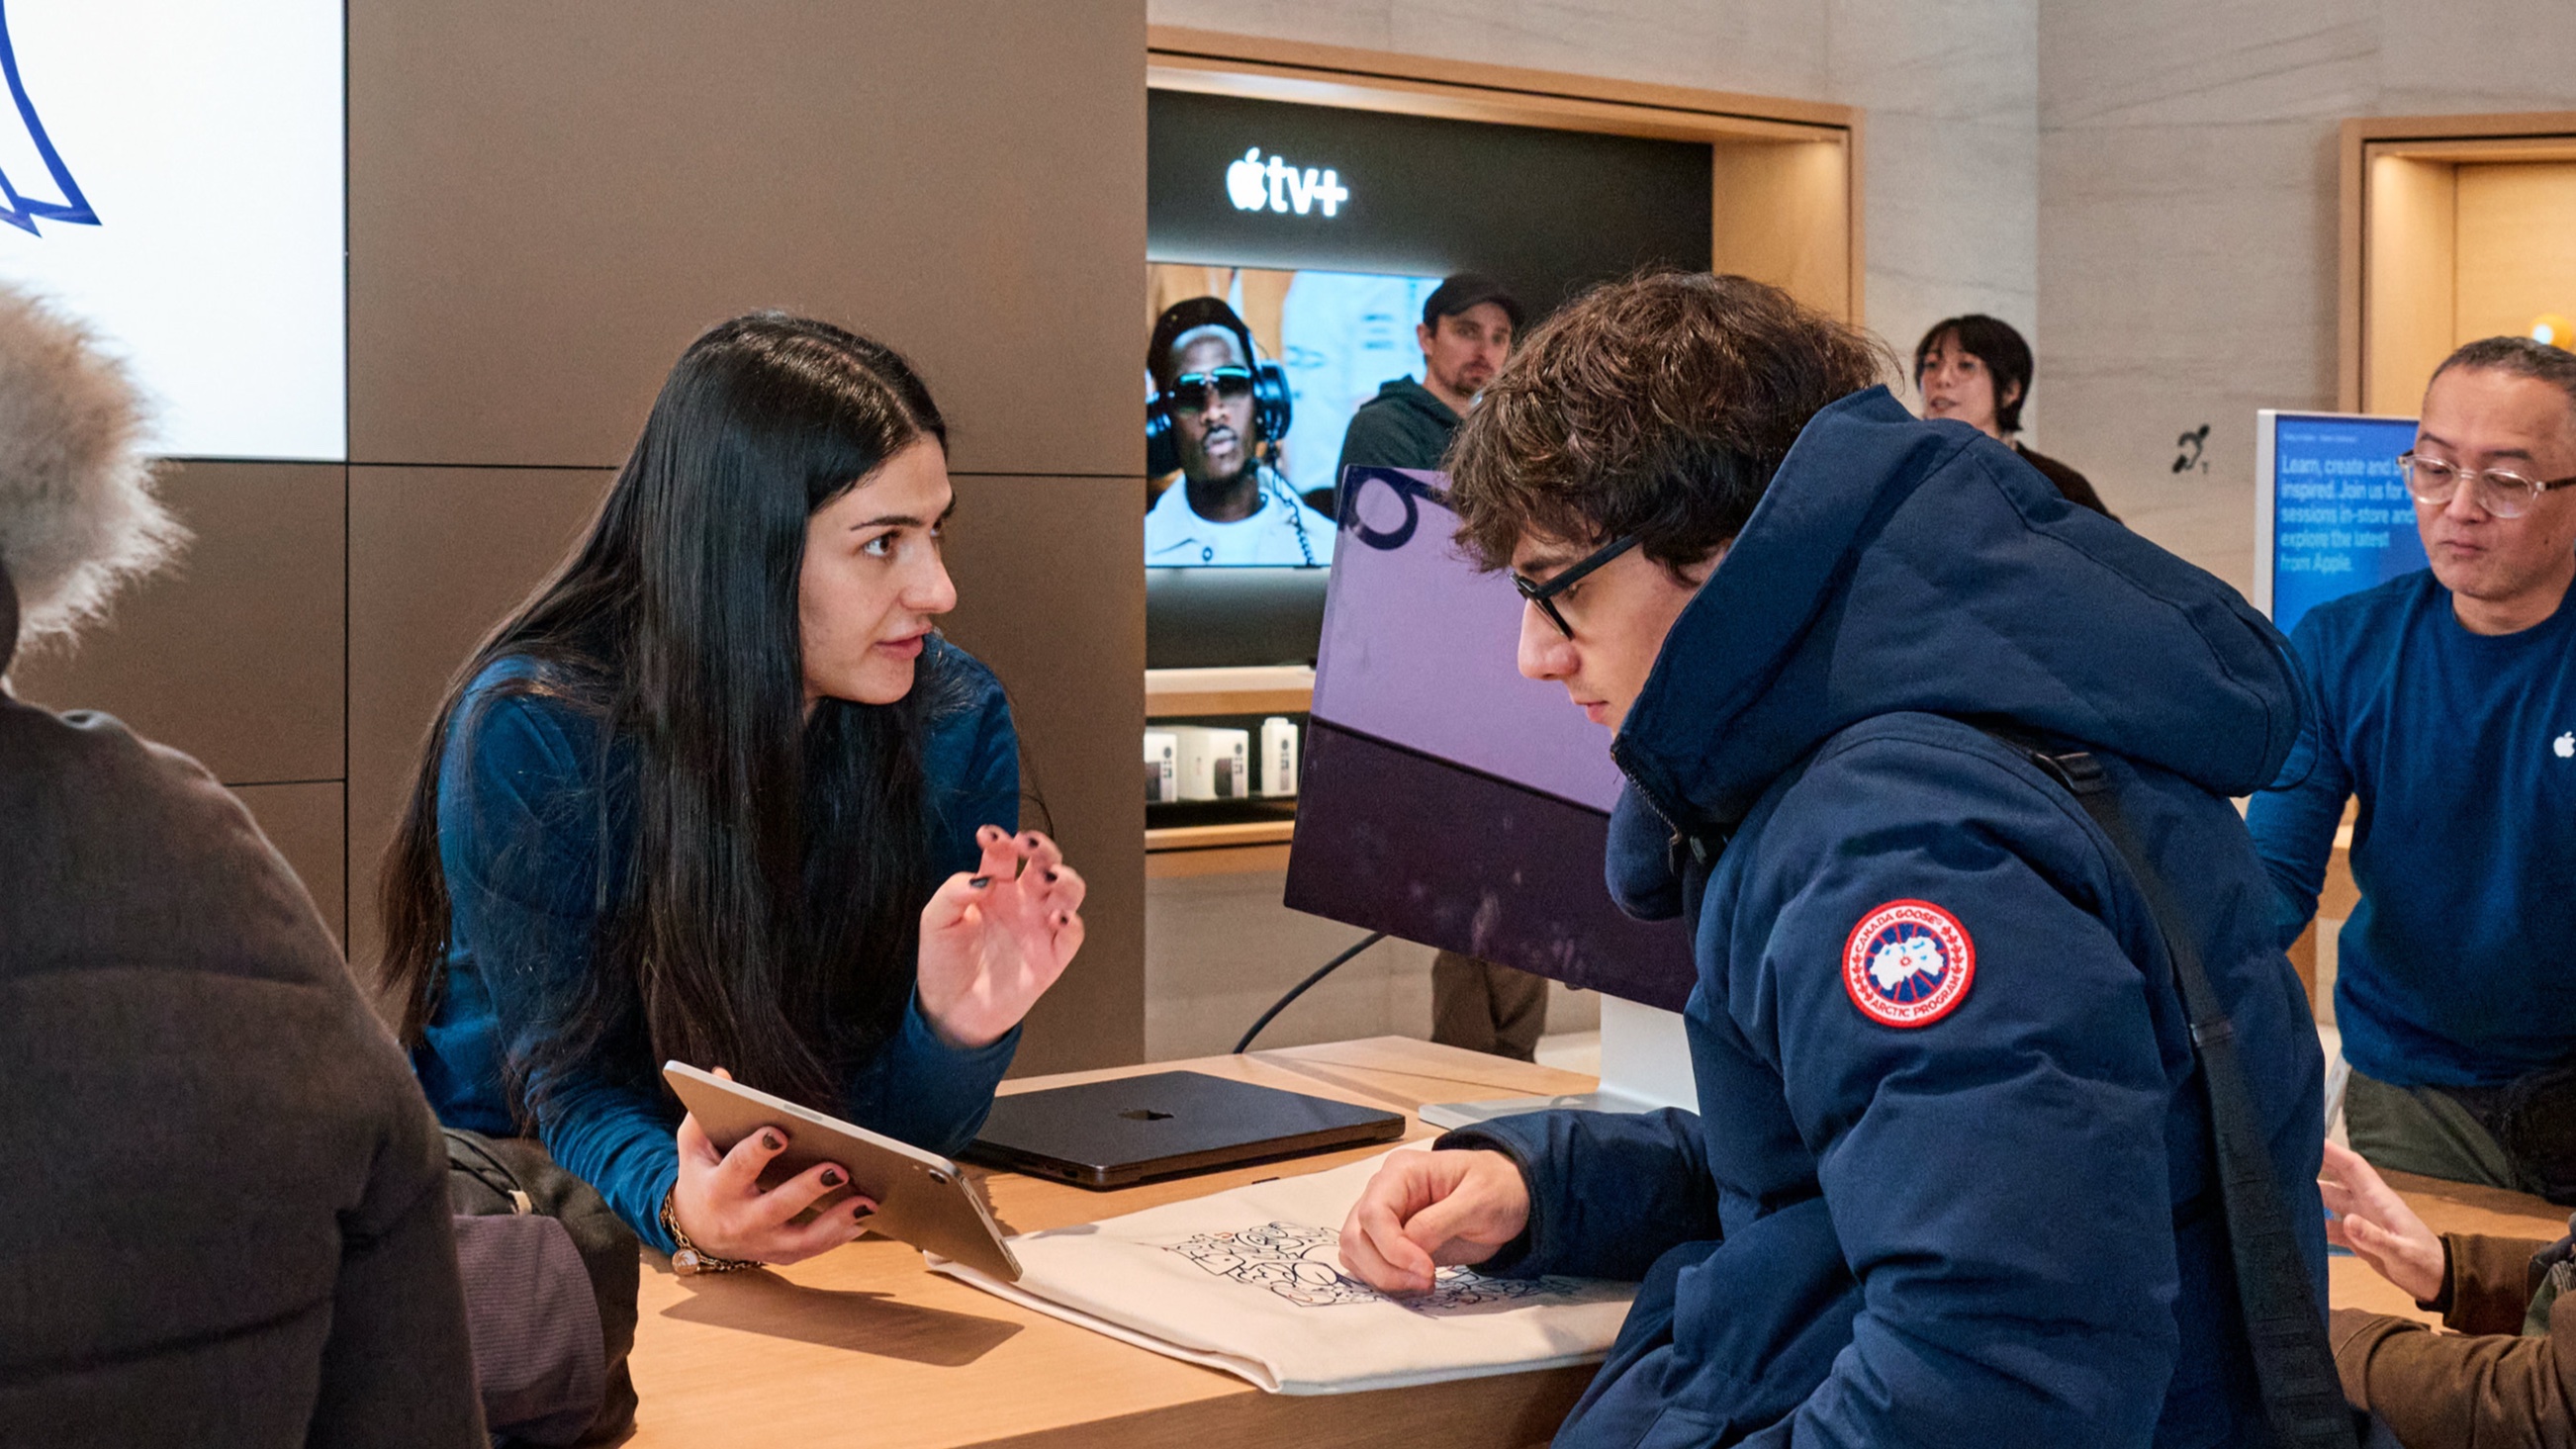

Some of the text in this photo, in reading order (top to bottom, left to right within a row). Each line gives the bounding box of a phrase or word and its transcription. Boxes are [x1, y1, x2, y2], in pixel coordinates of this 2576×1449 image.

[1265, 155, 1349, 218] tv+
[2281, 455, 2323, 478] Learn,
[2325, 459, 2365, 475] create
[2367, 458, 2392, 477] and
[2339, 481, 2366, 499] Join
[2368, 485, 2384, 500] us
[2385, 481, 2403, 500] for
[2281, 505, 2338, 523] sessions
[2340, 504, 2389, 524] in-store
[2280, 529, 2390, 550] explore the latest
[2280, 553, 2311, 571] from
[1855, 913, 1894, 953] CANADA
[1871, 974, 1961, 1018] ARCTIC PROGRAM
